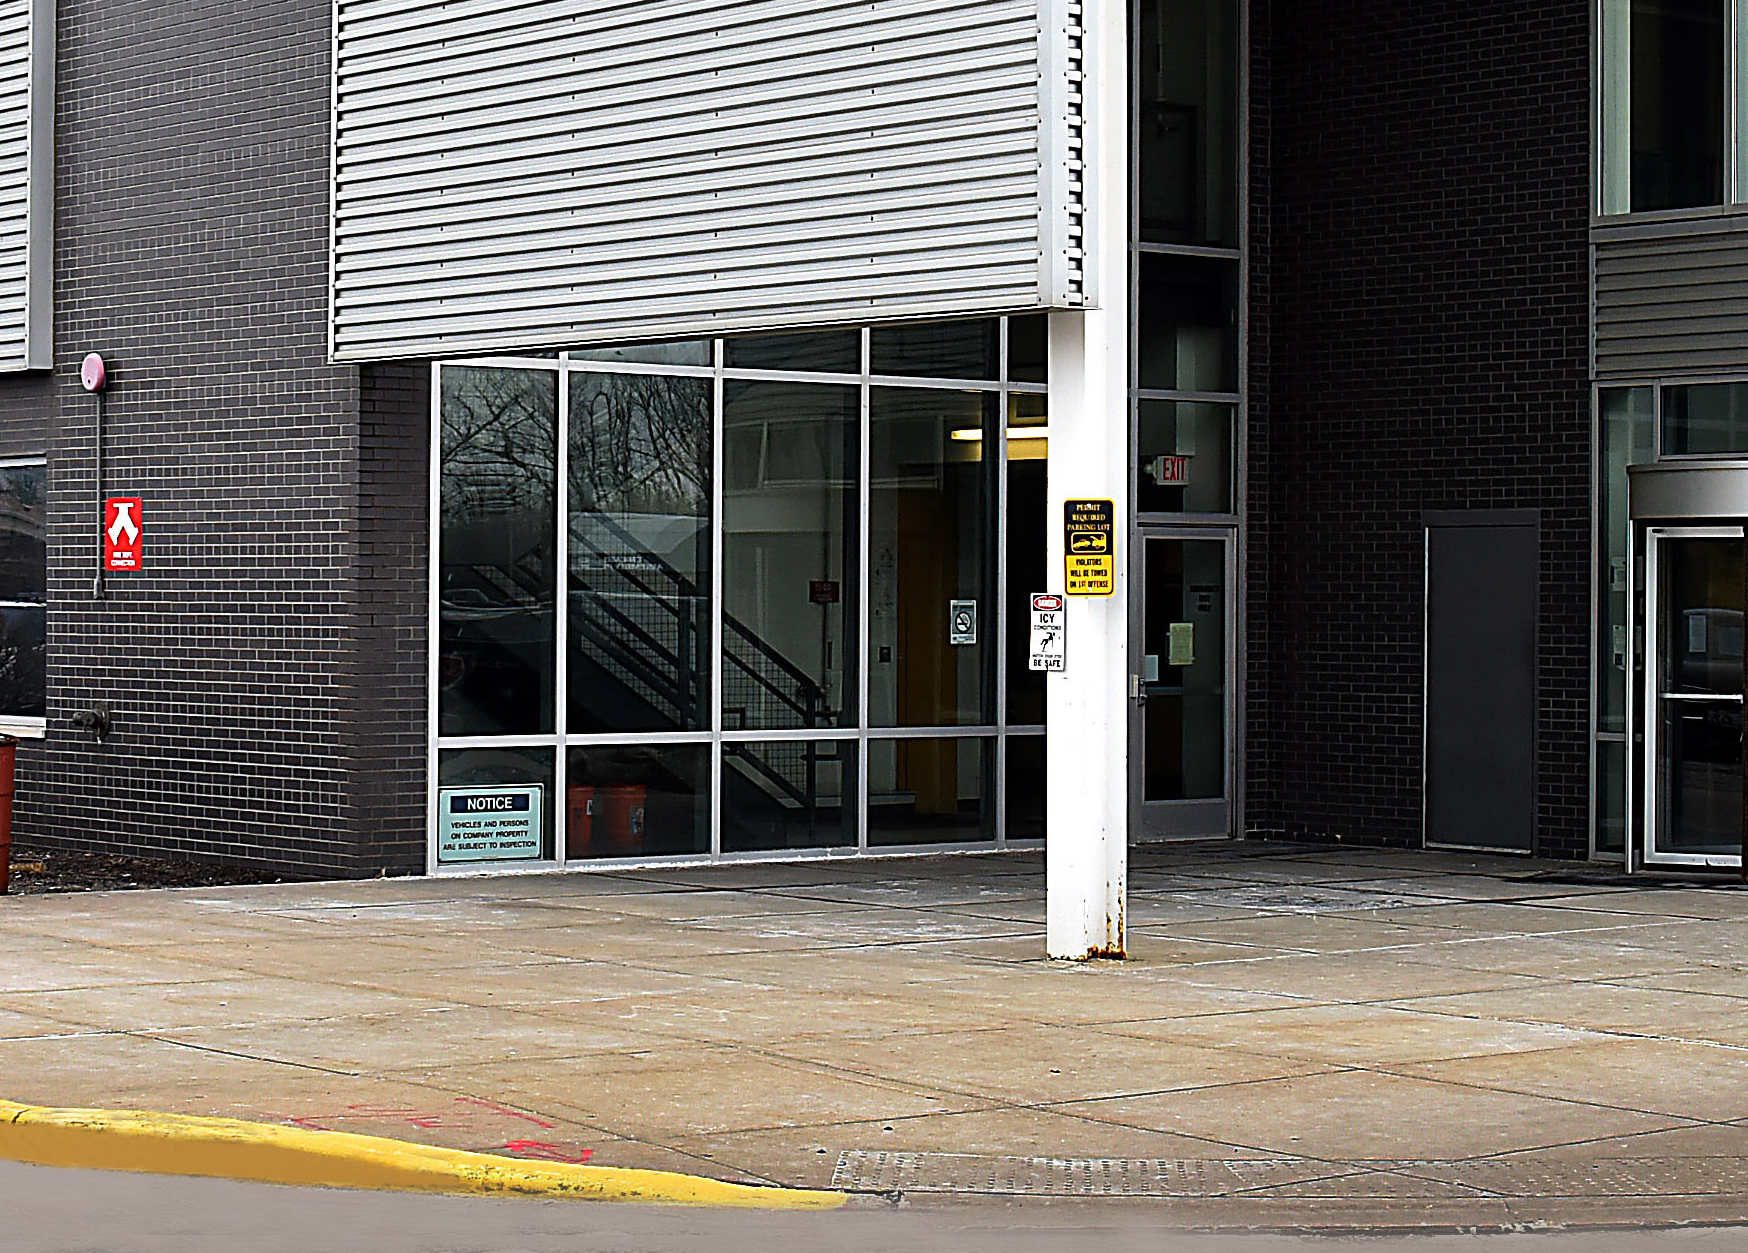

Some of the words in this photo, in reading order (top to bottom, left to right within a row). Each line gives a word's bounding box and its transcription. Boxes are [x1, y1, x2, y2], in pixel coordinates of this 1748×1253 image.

[1163, 458, 1186, 481] EXIT
[1072, 514, 1106, 522] REQUIRED
[1067, 523, 1096, 531] PARKING
[1097, 523, 1110, 531] LOT
[1076, 558, 1102, 566] VIOLATORS
[1070, 569, 1081, 577] WILL
[1091, 569, 1108, 577] TOWED
[1040, 613, 1055, 623] ICY
[1033, 659, 1042, 667] BE
[1045, 659, 1061, 668] SAFE
[467, 797, 513, 810] NOTICE
[499, 819, 529, 827] PERSONS
[463, 831, 494, 839] COMPANY
[496, 830, 529, 838] PROPERTY
[443, 843, 456, 851] ARE
[458, 842, 487, 850] SUBJECT
[489, 841, 498, 849] TO
[499, 840, 537, 849] INSPECTION
